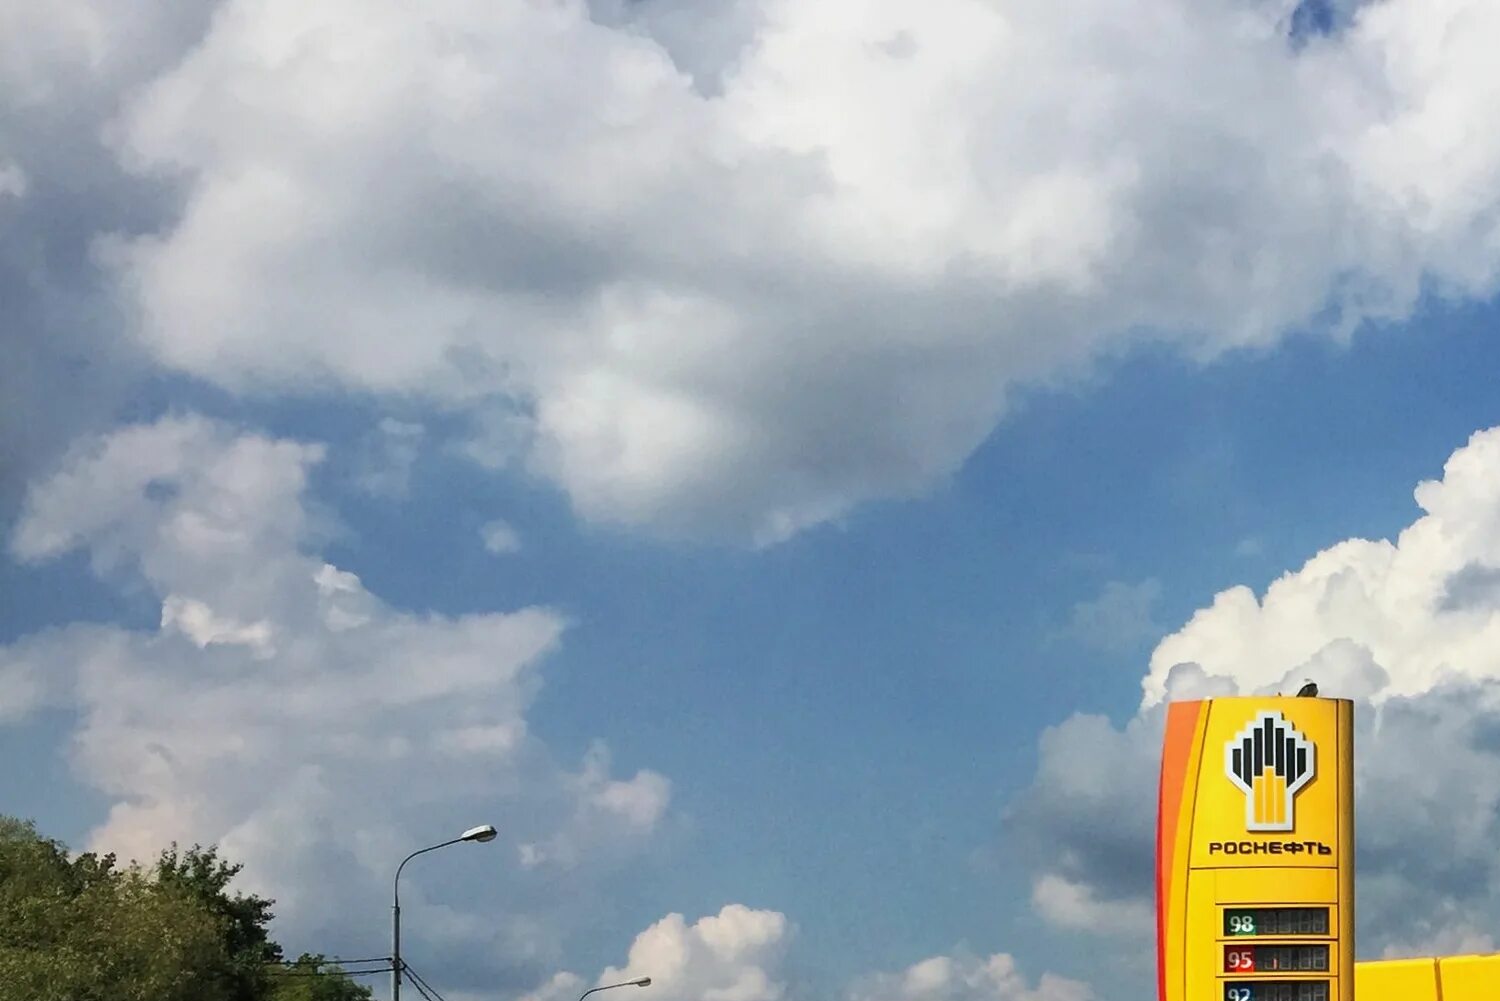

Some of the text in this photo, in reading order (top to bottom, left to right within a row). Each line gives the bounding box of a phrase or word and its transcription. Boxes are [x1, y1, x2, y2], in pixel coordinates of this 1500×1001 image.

[1208, 841, 1333, 855] РОСНЕФТЬ
[1230, 915, 1254, 933] 98
[1228, 951, 1253, 969] 95
